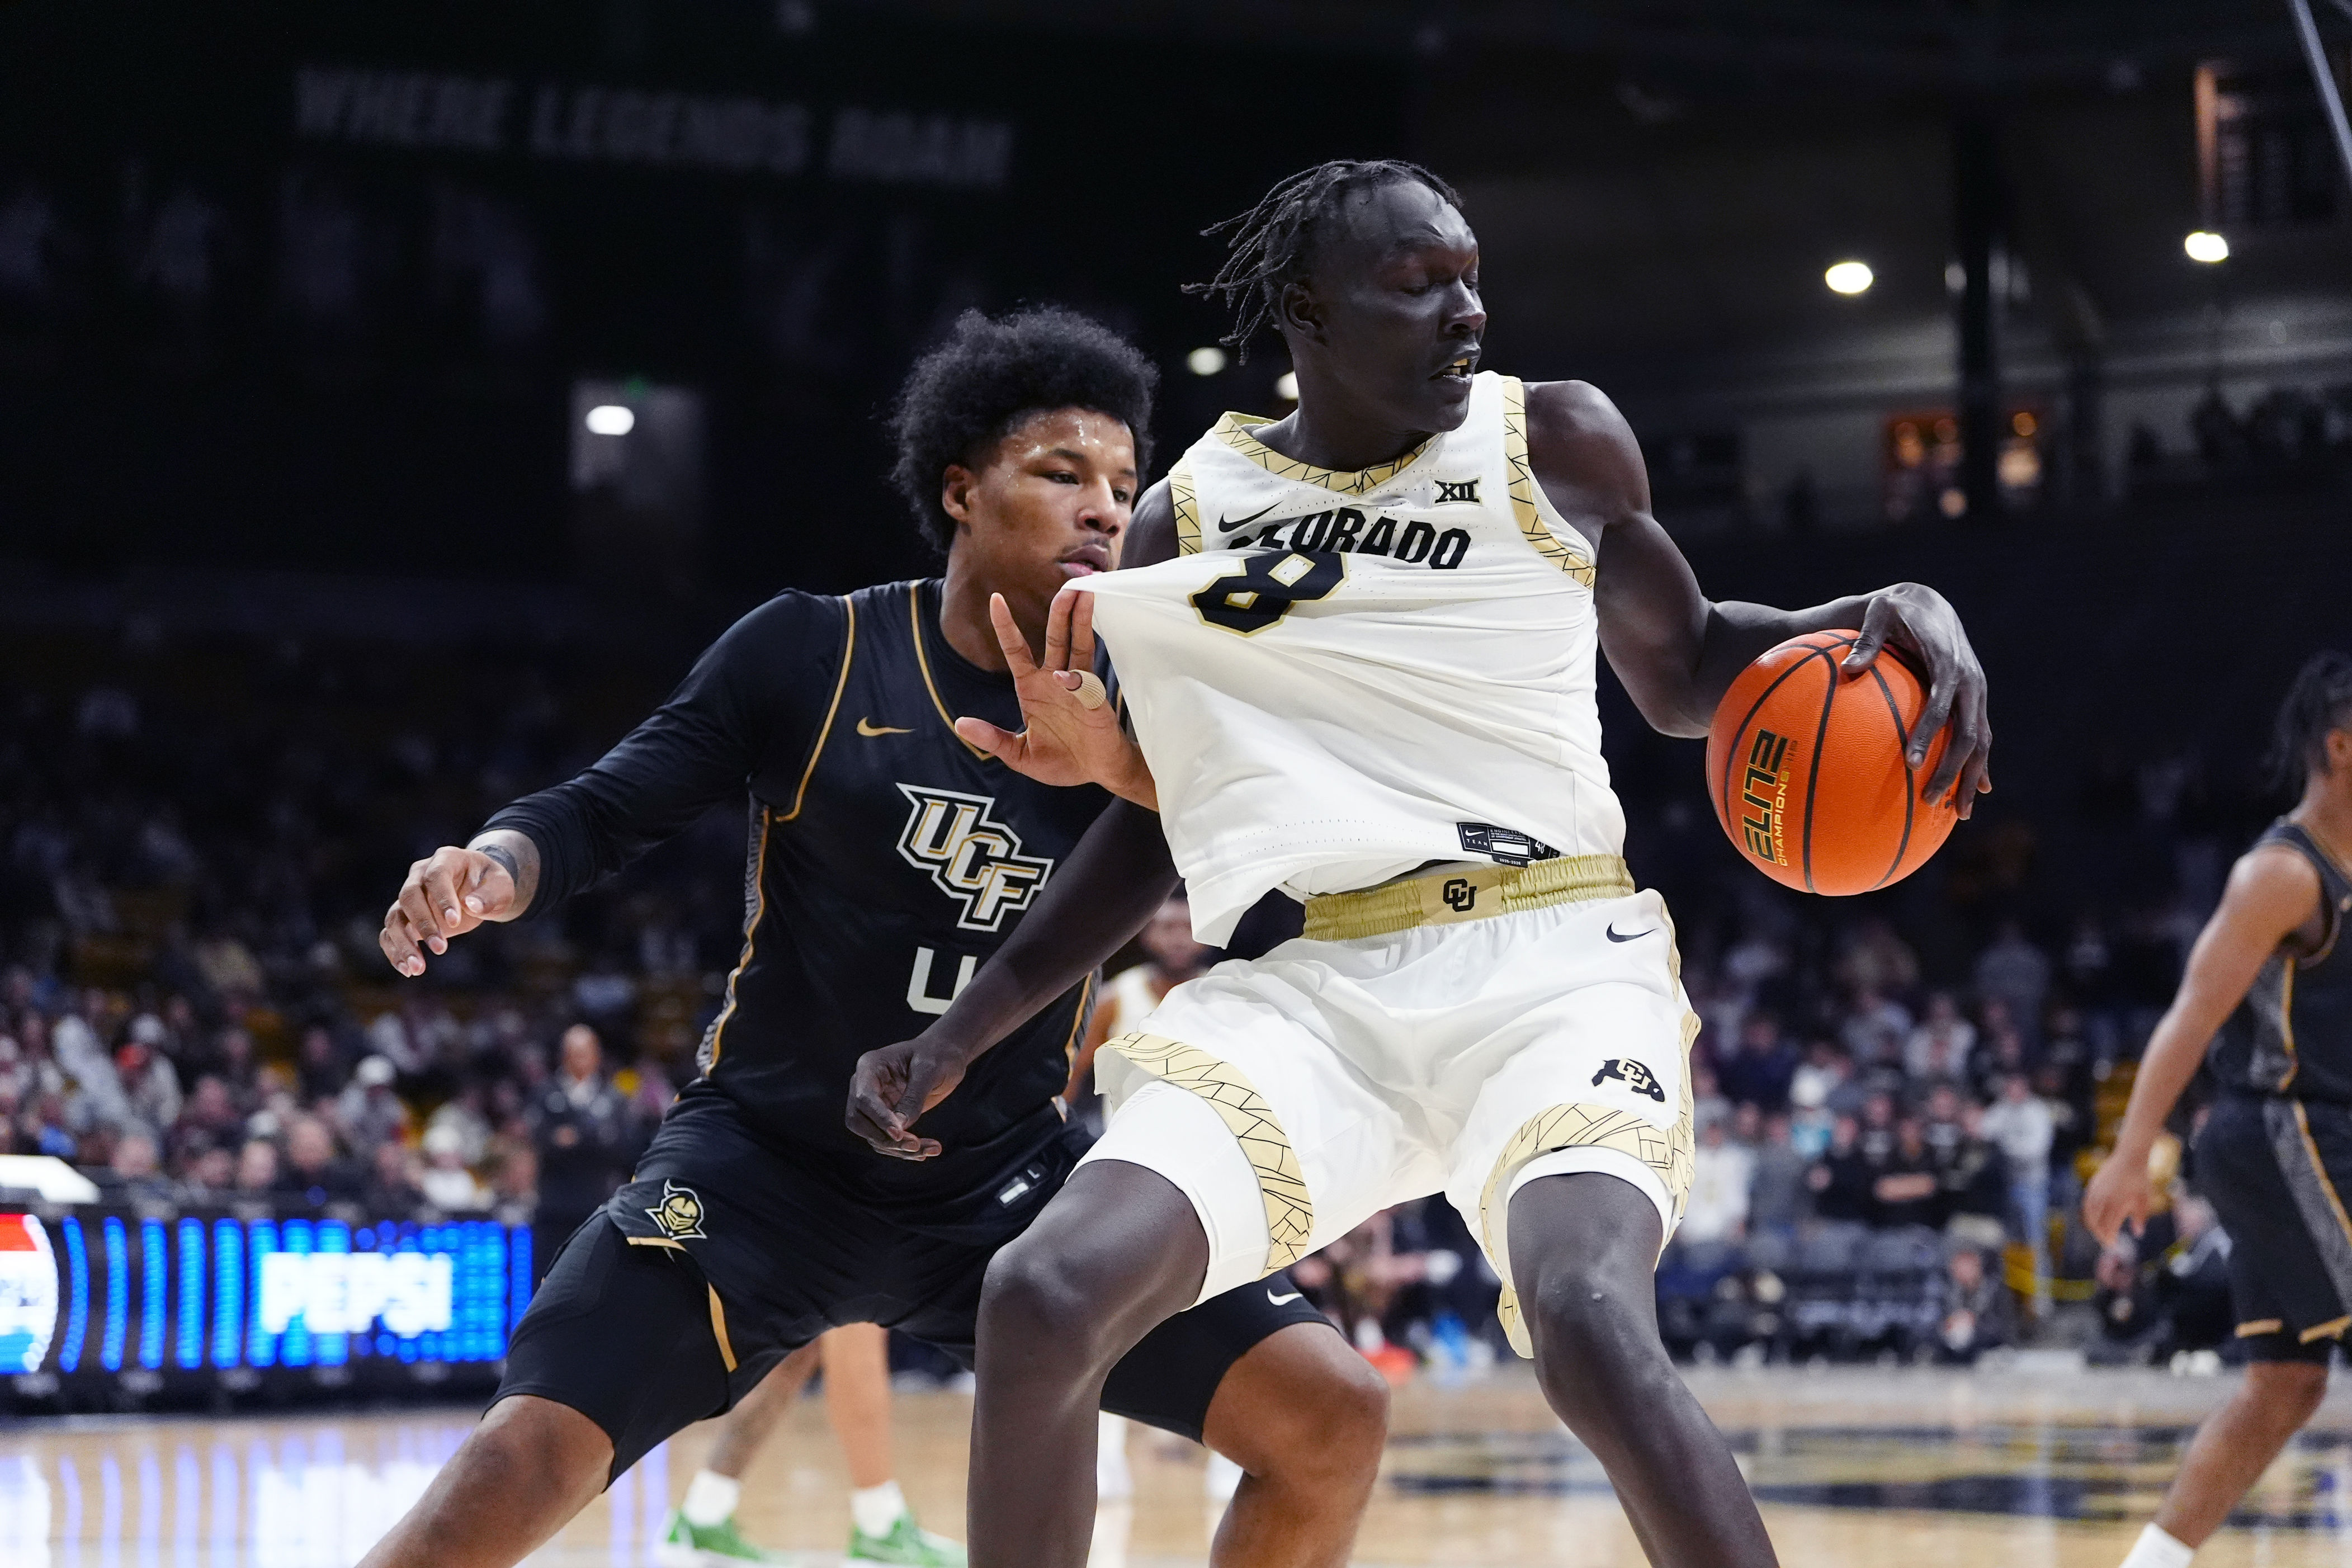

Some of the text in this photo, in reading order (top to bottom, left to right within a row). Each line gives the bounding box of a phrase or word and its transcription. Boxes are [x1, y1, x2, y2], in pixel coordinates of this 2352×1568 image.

[296, 68, 511, 147] WHERE
[531, 85, 809, 174] LEGENDS
[1434, 479, 1480, 504] XII
[1226, 507, 1471, 570] ORADO
[1187, 550, 1349, 638] 8
[1742, 728, 1788, 864] ELITE
[896, 783, 1054, 932] UCF
[1443, 878, 1477, 913] CU
[1616, 1058, 1652, 1090] CU
[261, 1251, 452, 1338] PEPSI
